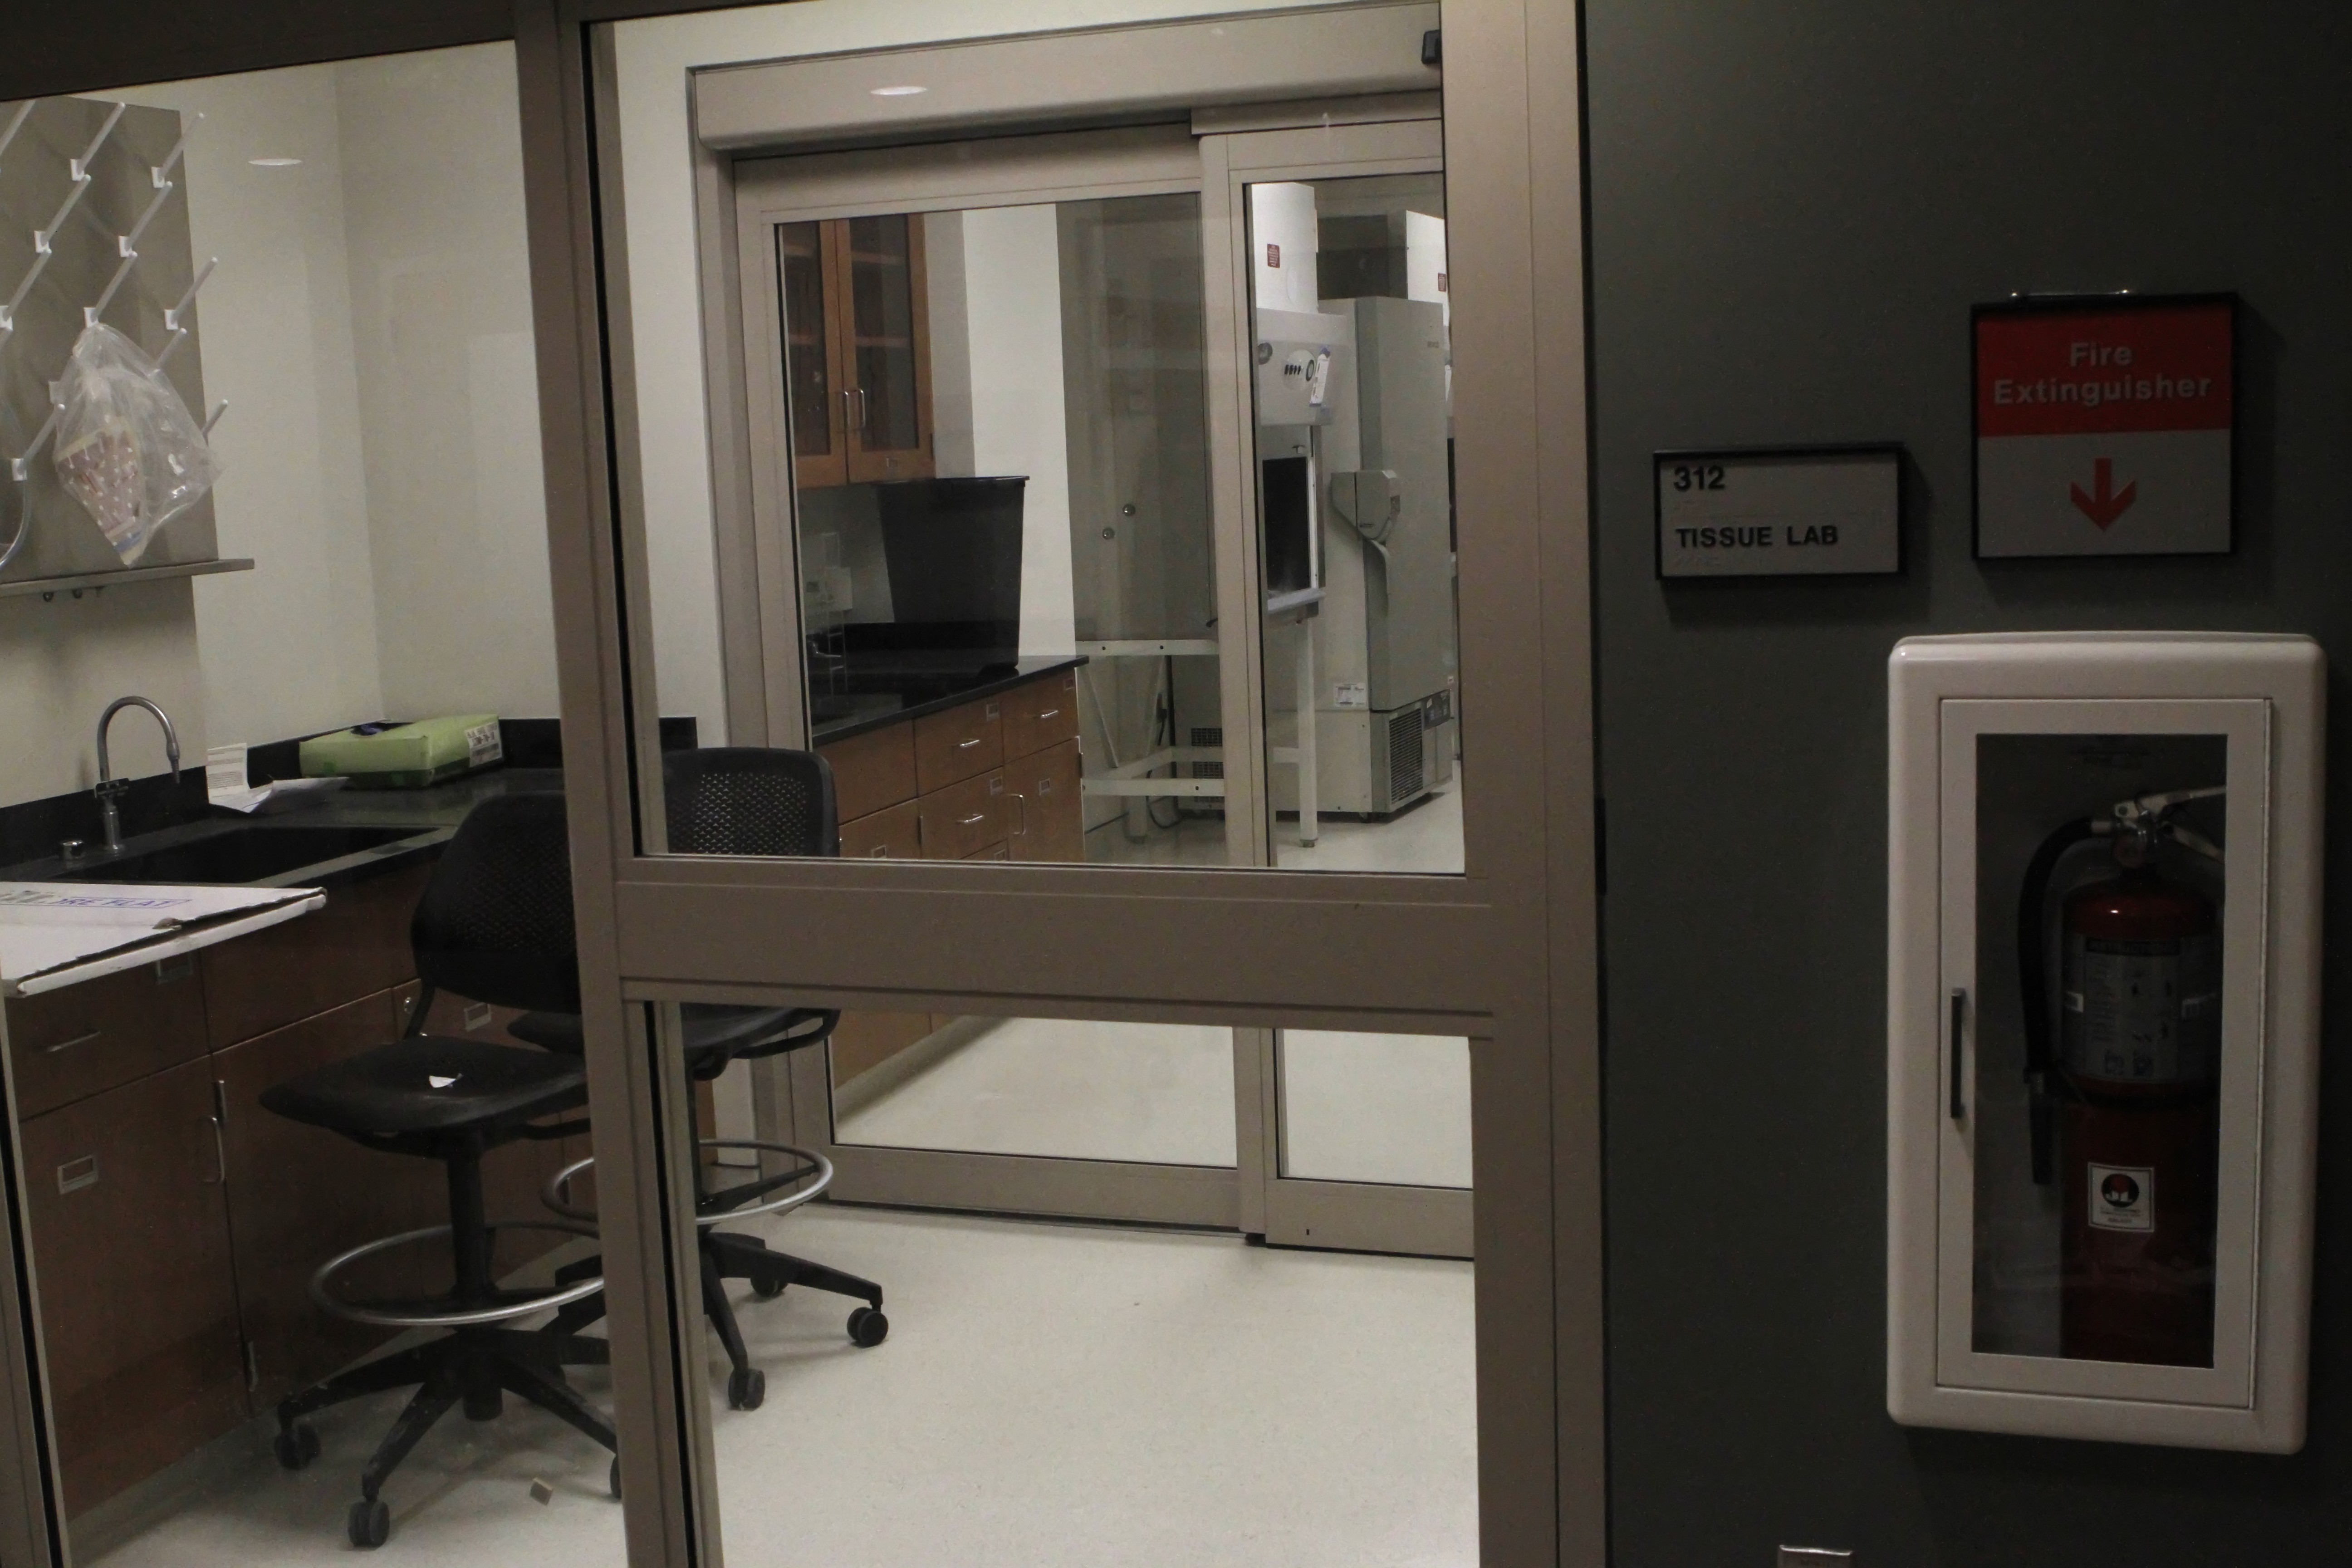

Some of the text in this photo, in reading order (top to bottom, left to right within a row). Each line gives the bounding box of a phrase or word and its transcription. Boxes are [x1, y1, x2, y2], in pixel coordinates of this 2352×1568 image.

[2070, 342, 2133, 367] Fire
[1994, 372, 2212, 407] Extinguisher
[1673, 465, 1725, 492] 312
[1676, 524, 1839, 548] TISSUE LAB
